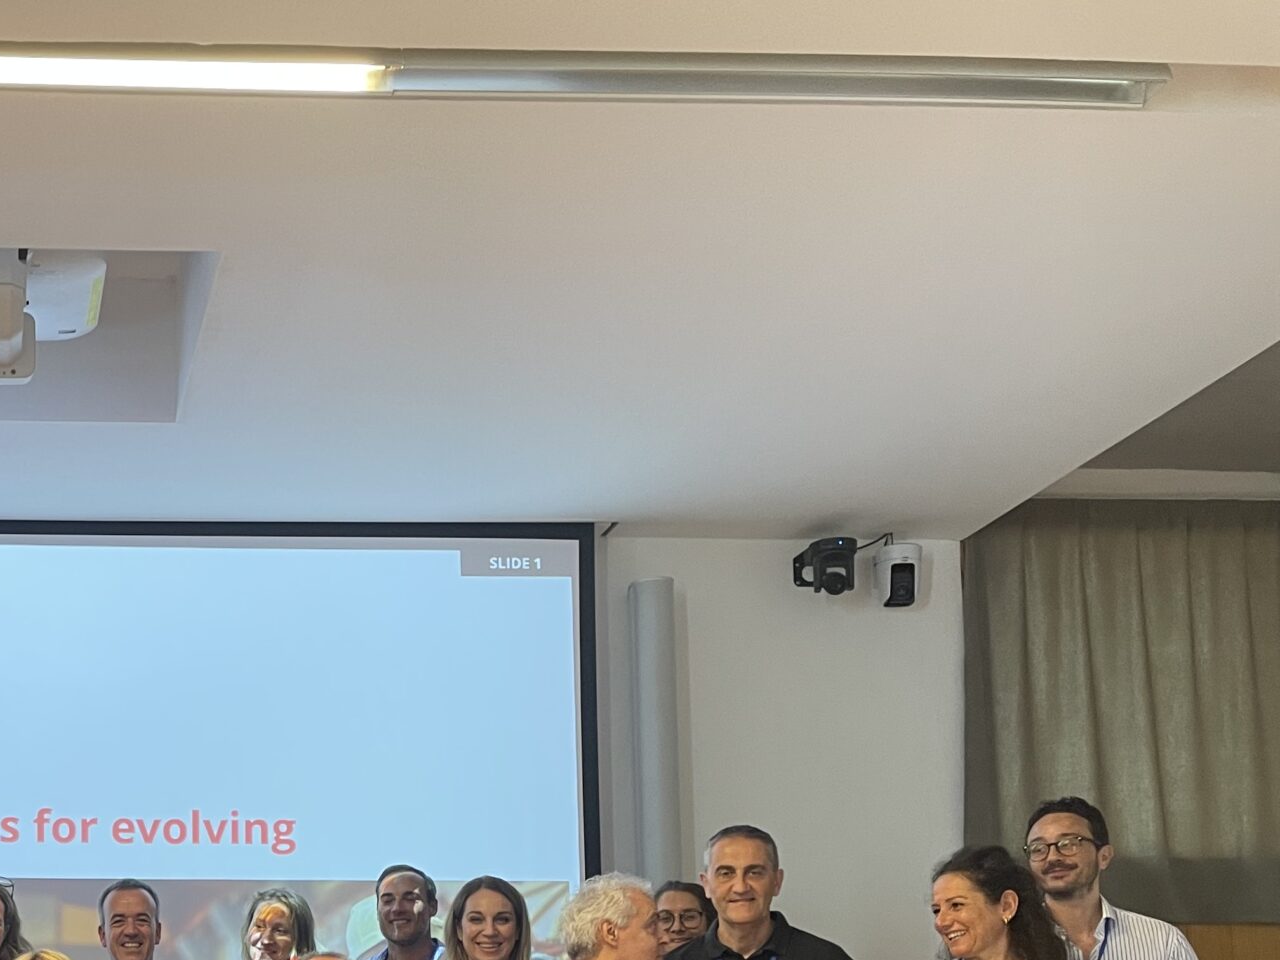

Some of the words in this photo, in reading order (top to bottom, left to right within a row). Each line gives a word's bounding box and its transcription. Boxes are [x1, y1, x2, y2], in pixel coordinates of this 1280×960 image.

[489, 556, 530, 569] SLIDE
[533, 557, 541, 570] 1
[33, 807, 98, 844] for
[111, 809, 297, 855] evolving
